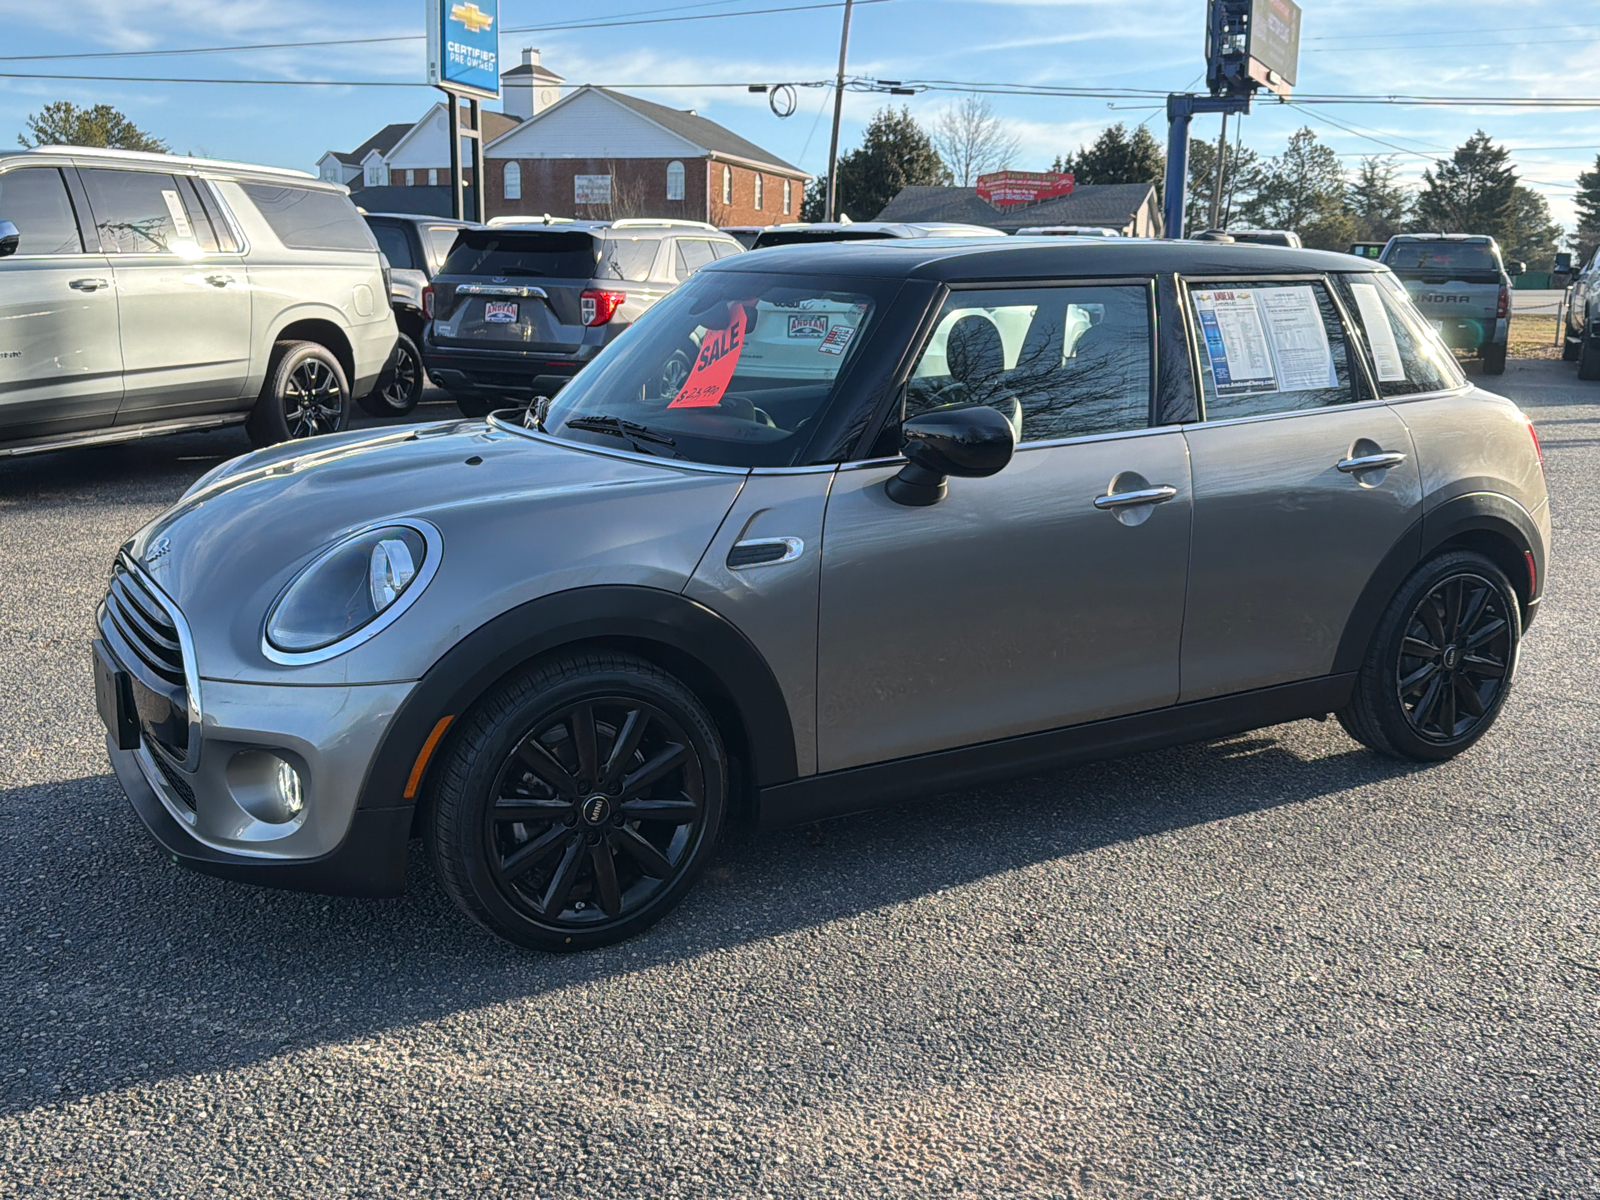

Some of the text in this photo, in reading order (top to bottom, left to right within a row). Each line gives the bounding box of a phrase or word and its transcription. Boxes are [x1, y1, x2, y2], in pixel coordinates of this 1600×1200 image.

[447, 41, 496, 63] CERTIFIED
[449, 52, 494, 72] PRE-OWNED
[1213, 291, 1236, 301] ANDEAN
[1411, 294, 1470, 303] UNDRA
[487, 305, 517, 315] ANDEAN
[791, 319, 825, 331] ANDEAN
[697, 321, 740, 372] SALE
[1216, 380, 1275, 389] www.AndeanChevy.com
[590, 800, 604, 821] MINI
